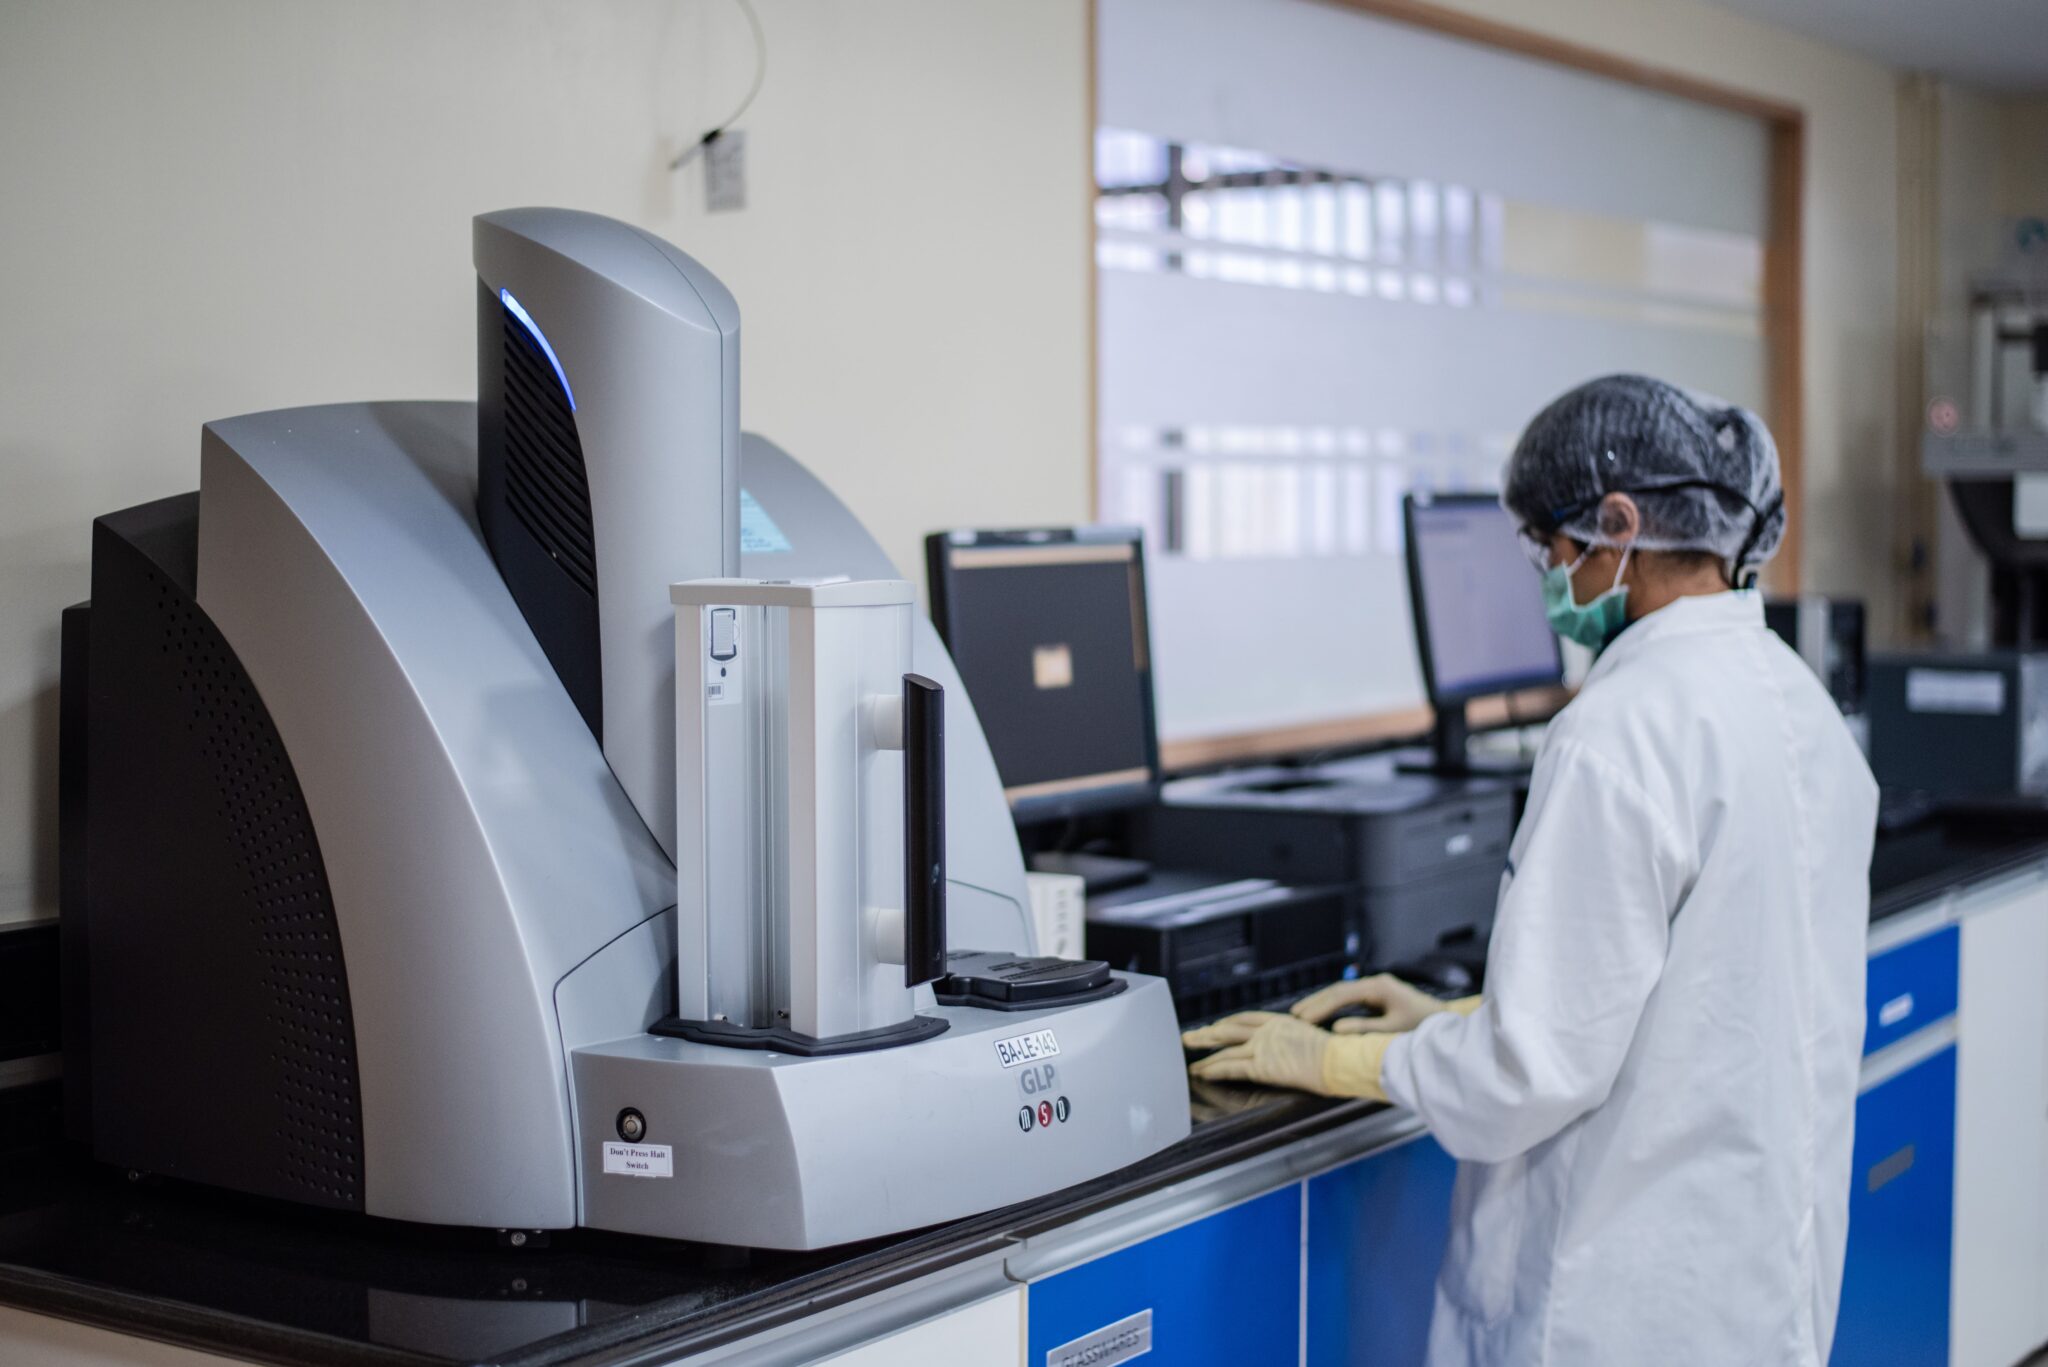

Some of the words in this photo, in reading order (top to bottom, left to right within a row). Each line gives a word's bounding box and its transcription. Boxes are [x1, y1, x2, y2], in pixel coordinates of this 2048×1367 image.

[1020, 1063, 1055, 1095] GLP
[610, 1148, 629, 1156] Don't
[630, 1149, 649, 1158] Press
[650, 1150, 665, 1159] Halt
[626, 1161, 649, 1170] Switch
